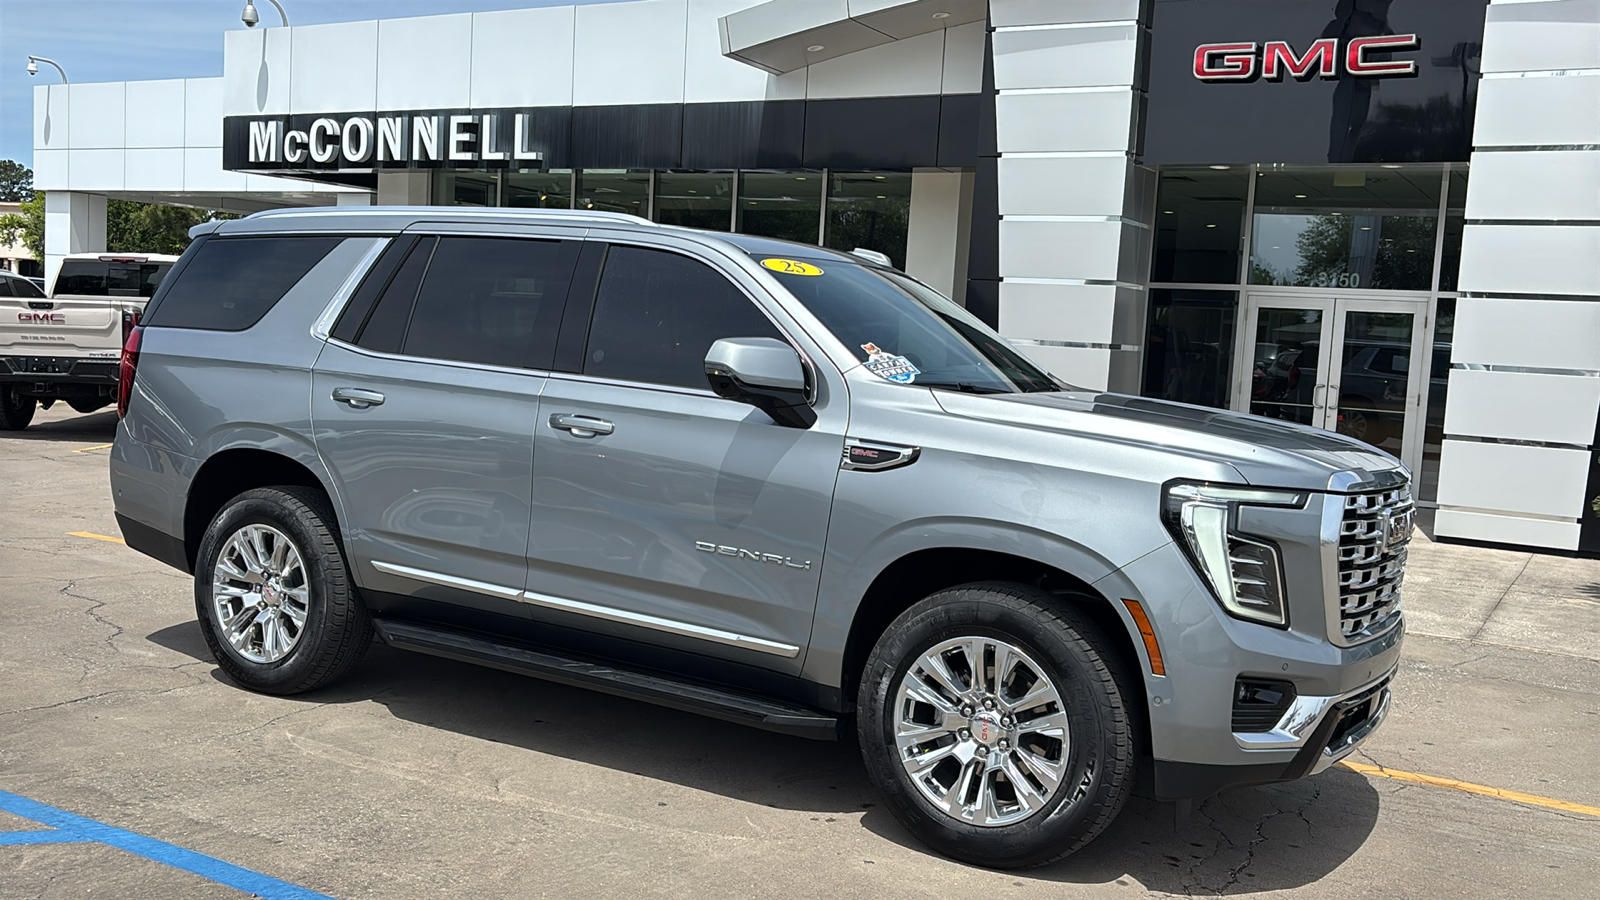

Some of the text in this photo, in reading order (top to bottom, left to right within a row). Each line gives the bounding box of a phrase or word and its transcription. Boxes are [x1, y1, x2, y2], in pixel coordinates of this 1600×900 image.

[1193, 33, 1417, 80] GMC
[248, 113, 543, 163] McCONNELL
[780, 260, 806, 274] 25
[1317, 271, 1360, 288] 3150
[18, 312, 65, 323] GMC
[851, 448, 879, 458] GMC
[695, 541, 811, 570] DENALI
